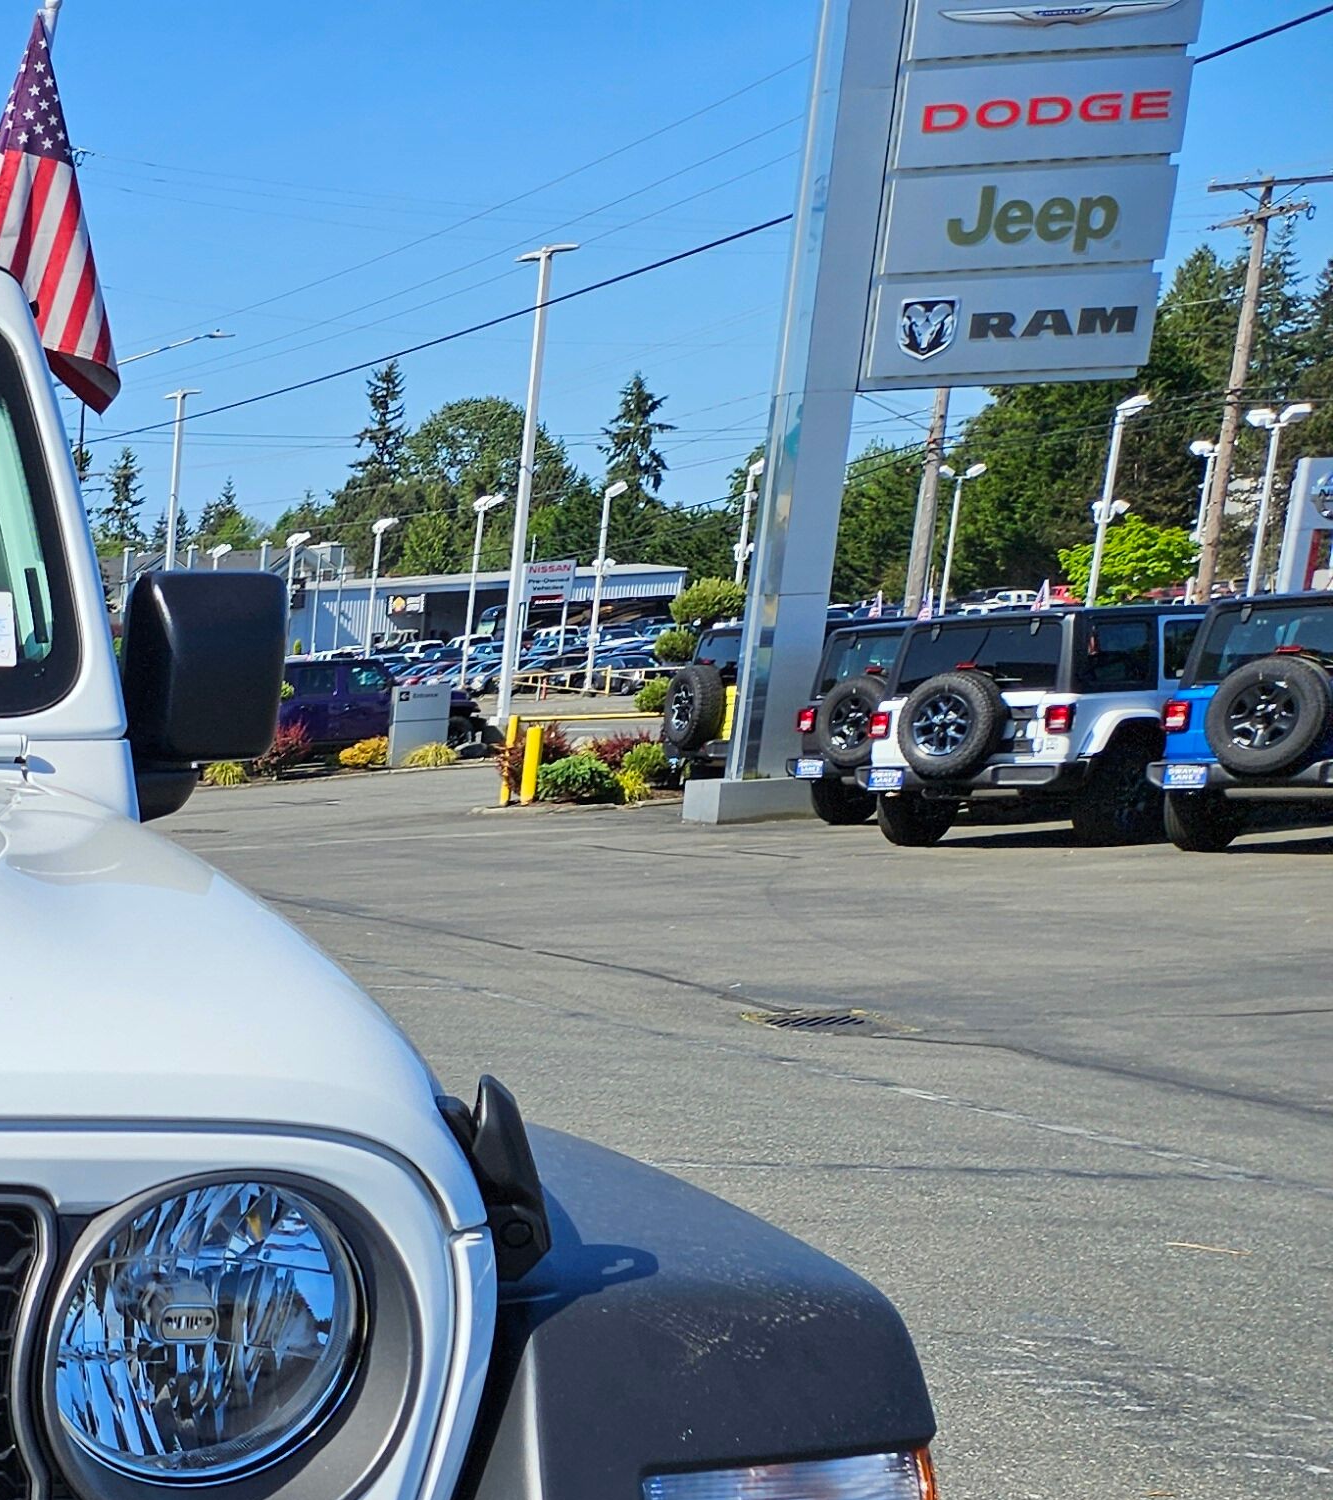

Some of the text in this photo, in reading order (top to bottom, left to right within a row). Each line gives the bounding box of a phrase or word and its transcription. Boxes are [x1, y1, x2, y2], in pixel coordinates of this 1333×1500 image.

[921, 90, 1173, 134] DODGE
[946, 185, 1120, 254] Jeep
[968, 305, 1139, 341] RAM
[527, 577, 570, 585] Pre-Owned
[528, 564, 572, 574] NISSAN
